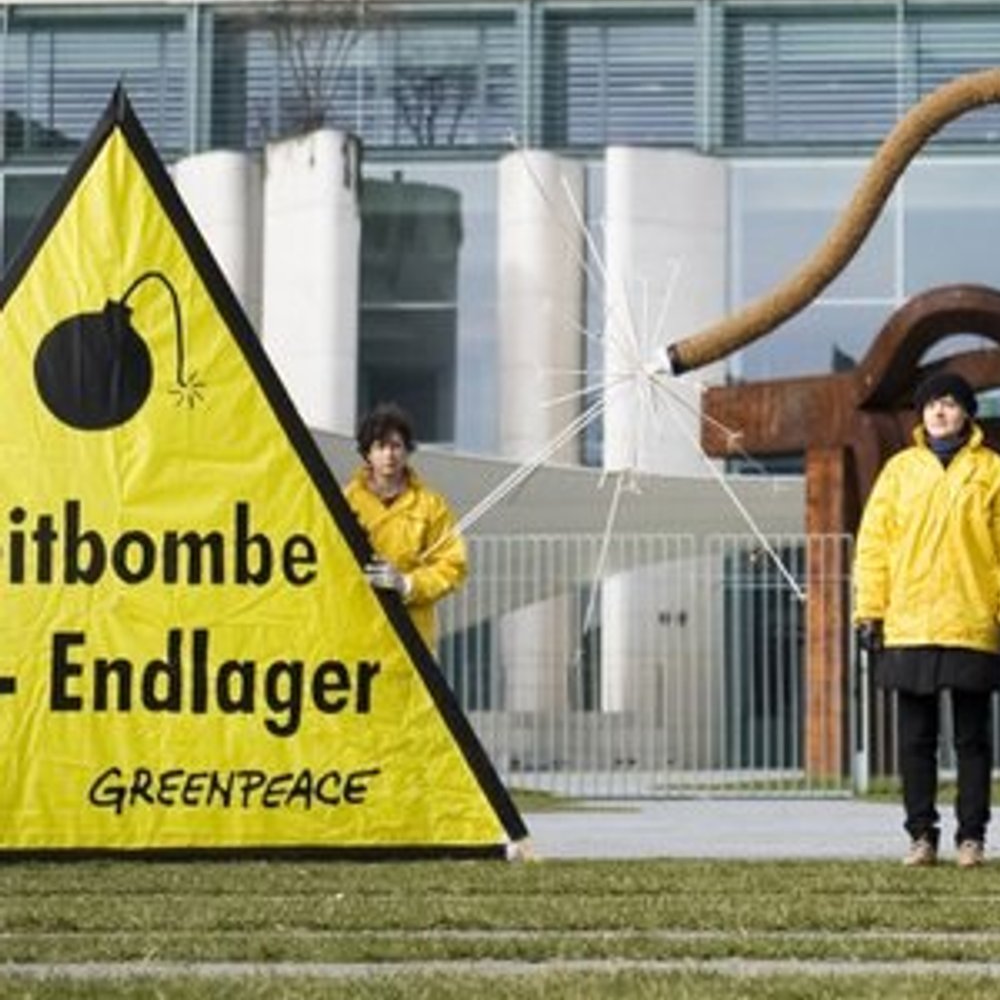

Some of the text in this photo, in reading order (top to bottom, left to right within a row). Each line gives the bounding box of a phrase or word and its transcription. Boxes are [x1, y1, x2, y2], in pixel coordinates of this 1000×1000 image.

[0, 499, 318, 587] itbombe
[50, 628, 382, 738] Endlager
[88, 766, 382, 816] GREENPEACE
